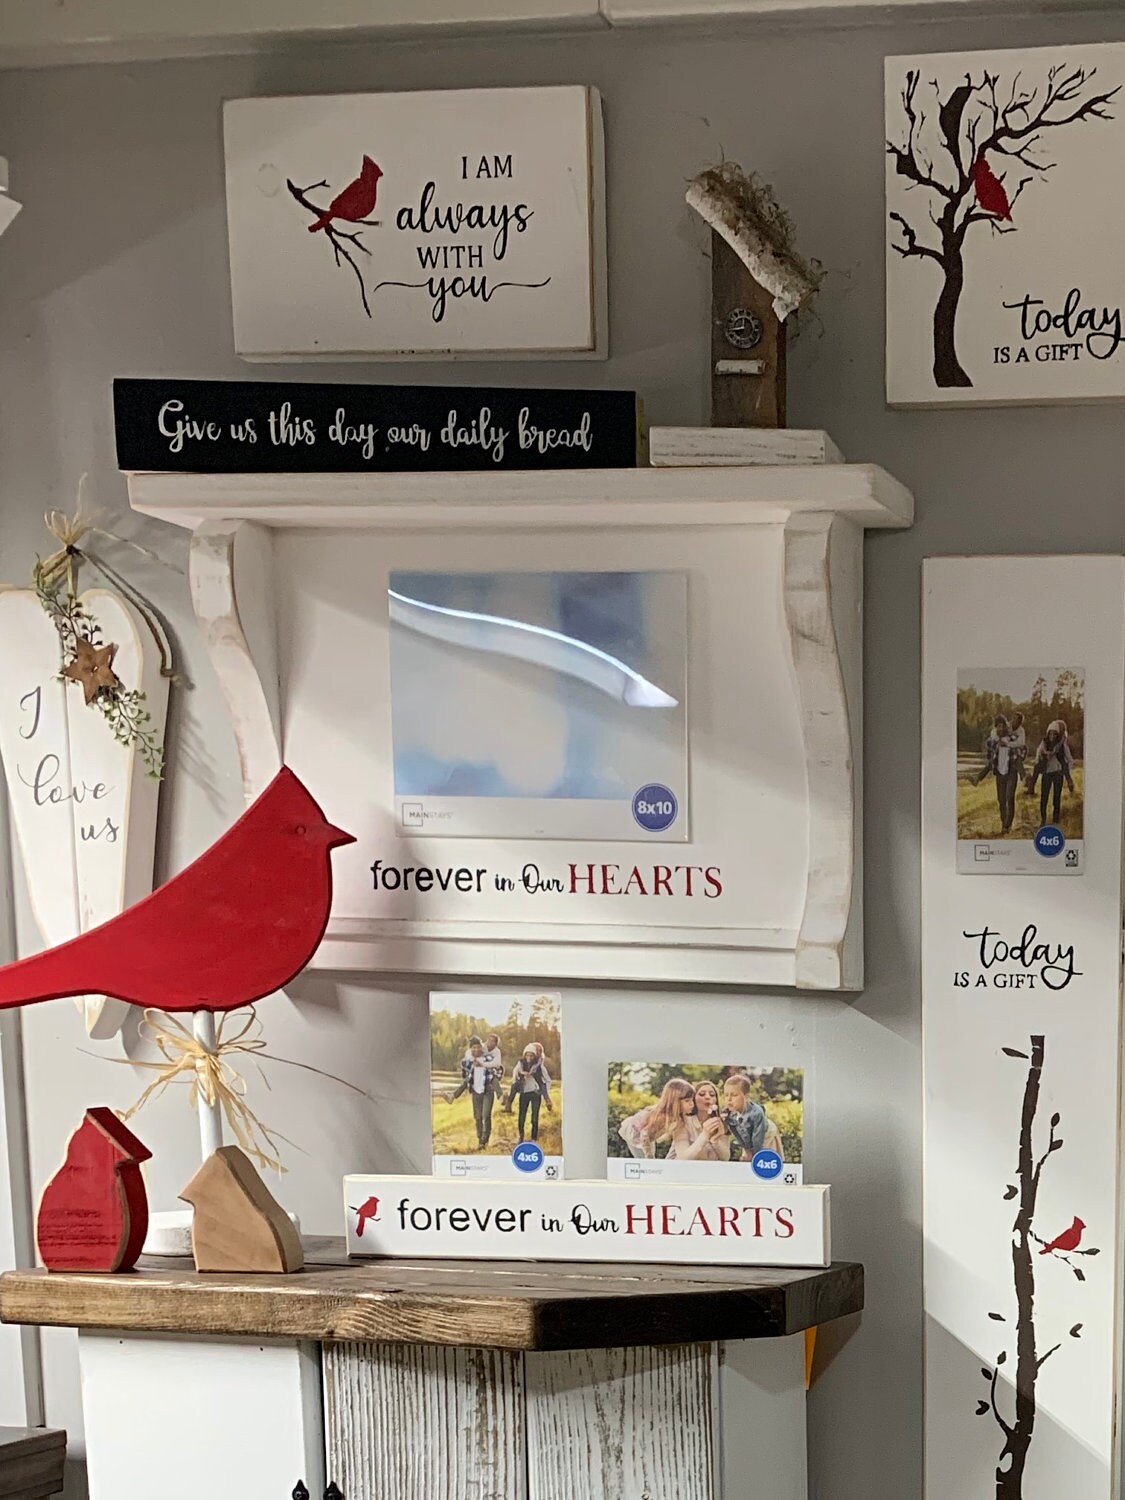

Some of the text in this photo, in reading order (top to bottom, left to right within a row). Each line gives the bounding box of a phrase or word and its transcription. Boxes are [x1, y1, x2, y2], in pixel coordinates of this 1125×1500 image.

[462, 155, 513, 179] I AM
[396, 181, 535, 261] always
[417, 245, 483, 269] WITH
[993, 343, 1083, 363] IS A GIFT
[158, 399, 593, 462] Give us this day our daily bread
[19, 686, 41, 740] I
[17, 753, 116, 806] love
[637, 800, 674, 817] 8x10
[80, 817, 120, 843] us
[1040, 835, 1060, 847] 4x6
[370, 859, 723, 898] forever in Our HEARTS
[963, 924, 1083, 990] today
[953, 972, 1038, 988] IS A GIFT
[517, 1152, 539, 1163] 4x6
[756, 1159, 778, 1170] 4x6
[397, 1198, 795, 1239] forever in Our HEARTS
